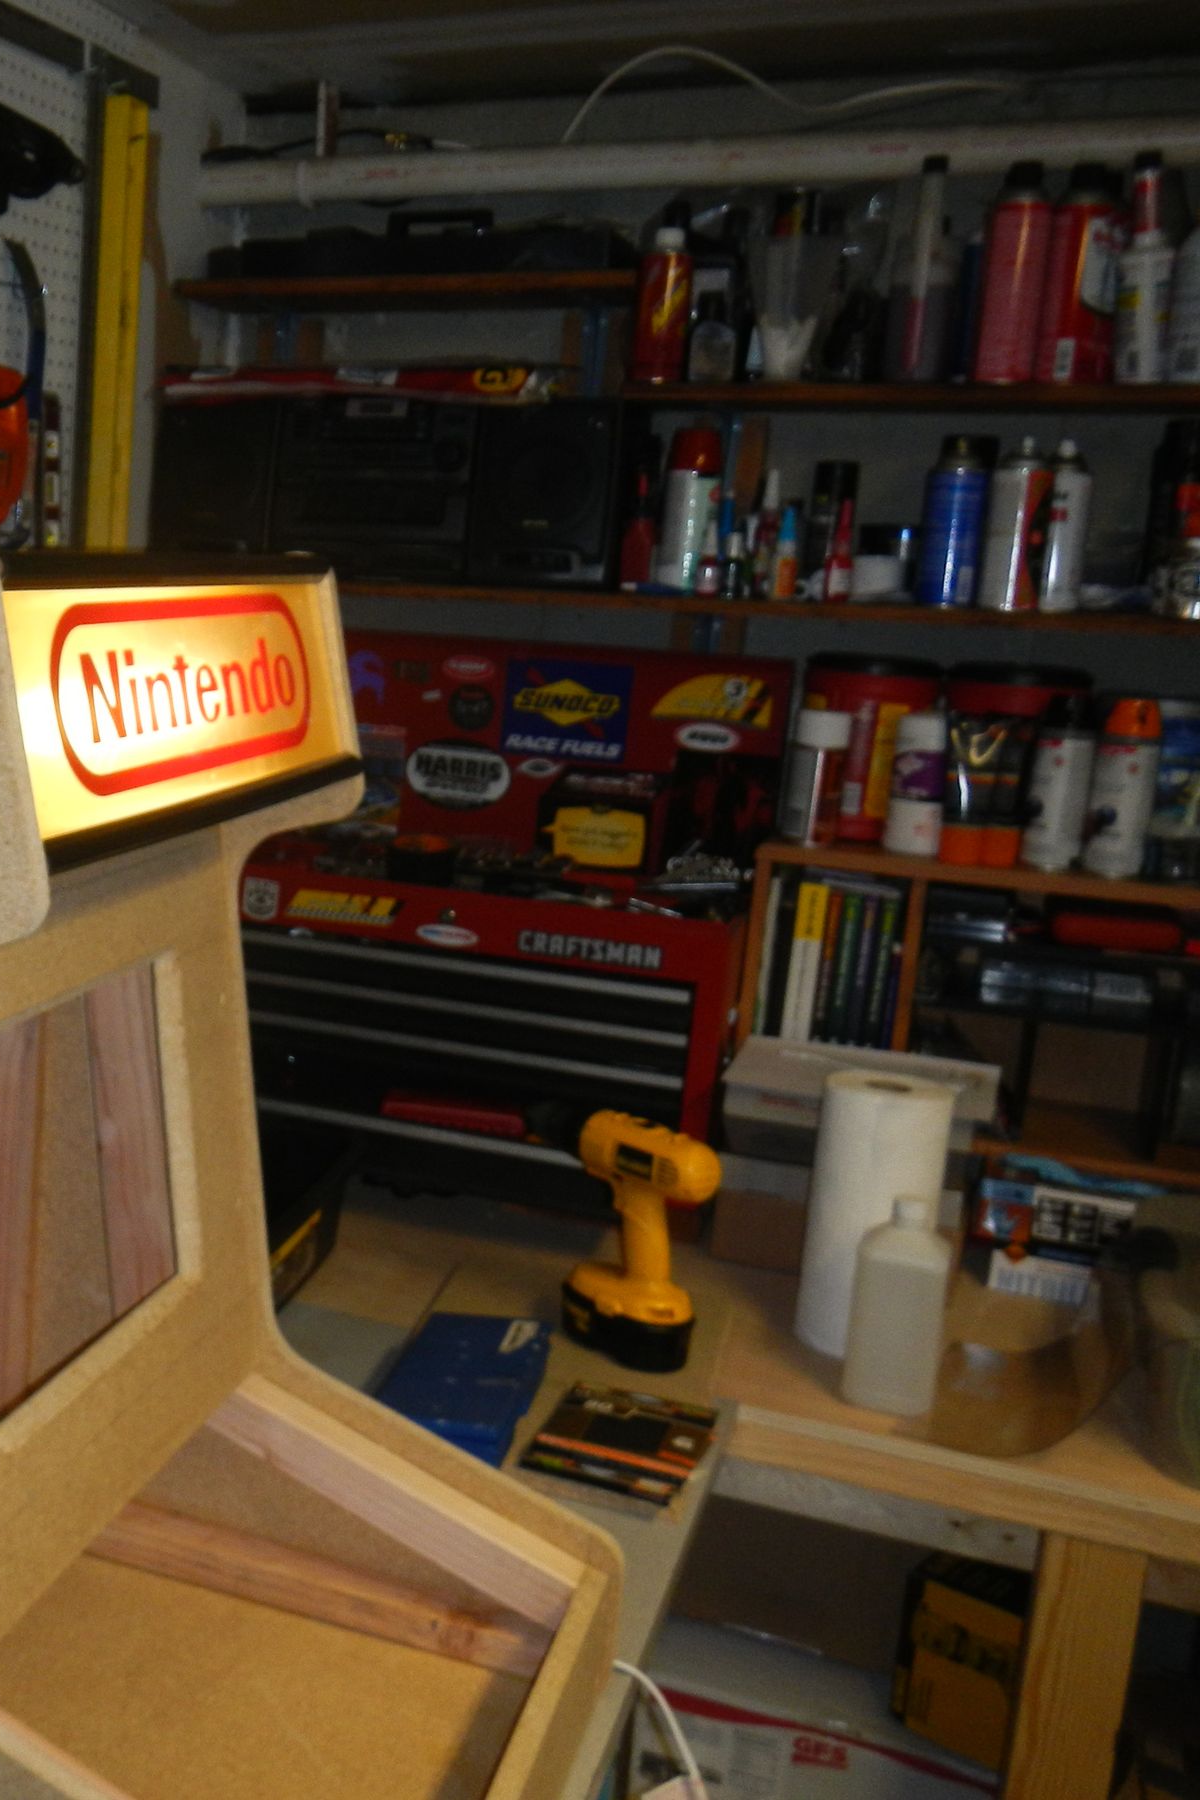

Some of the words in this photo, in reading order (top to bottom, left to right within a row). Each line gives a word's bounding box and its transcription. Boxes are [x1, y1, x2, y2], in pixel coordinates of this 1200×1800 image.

[78, 637, 296, 743] Nintendo
[519, 690, 615, 714] SUNOCO
[505, 733, 559, 754] RACE
[561, 740, 620, 758] FUELS
[416, 752, 503, 781] HARRIS
[518, 930, 662, 968] CRAFTSMAN
